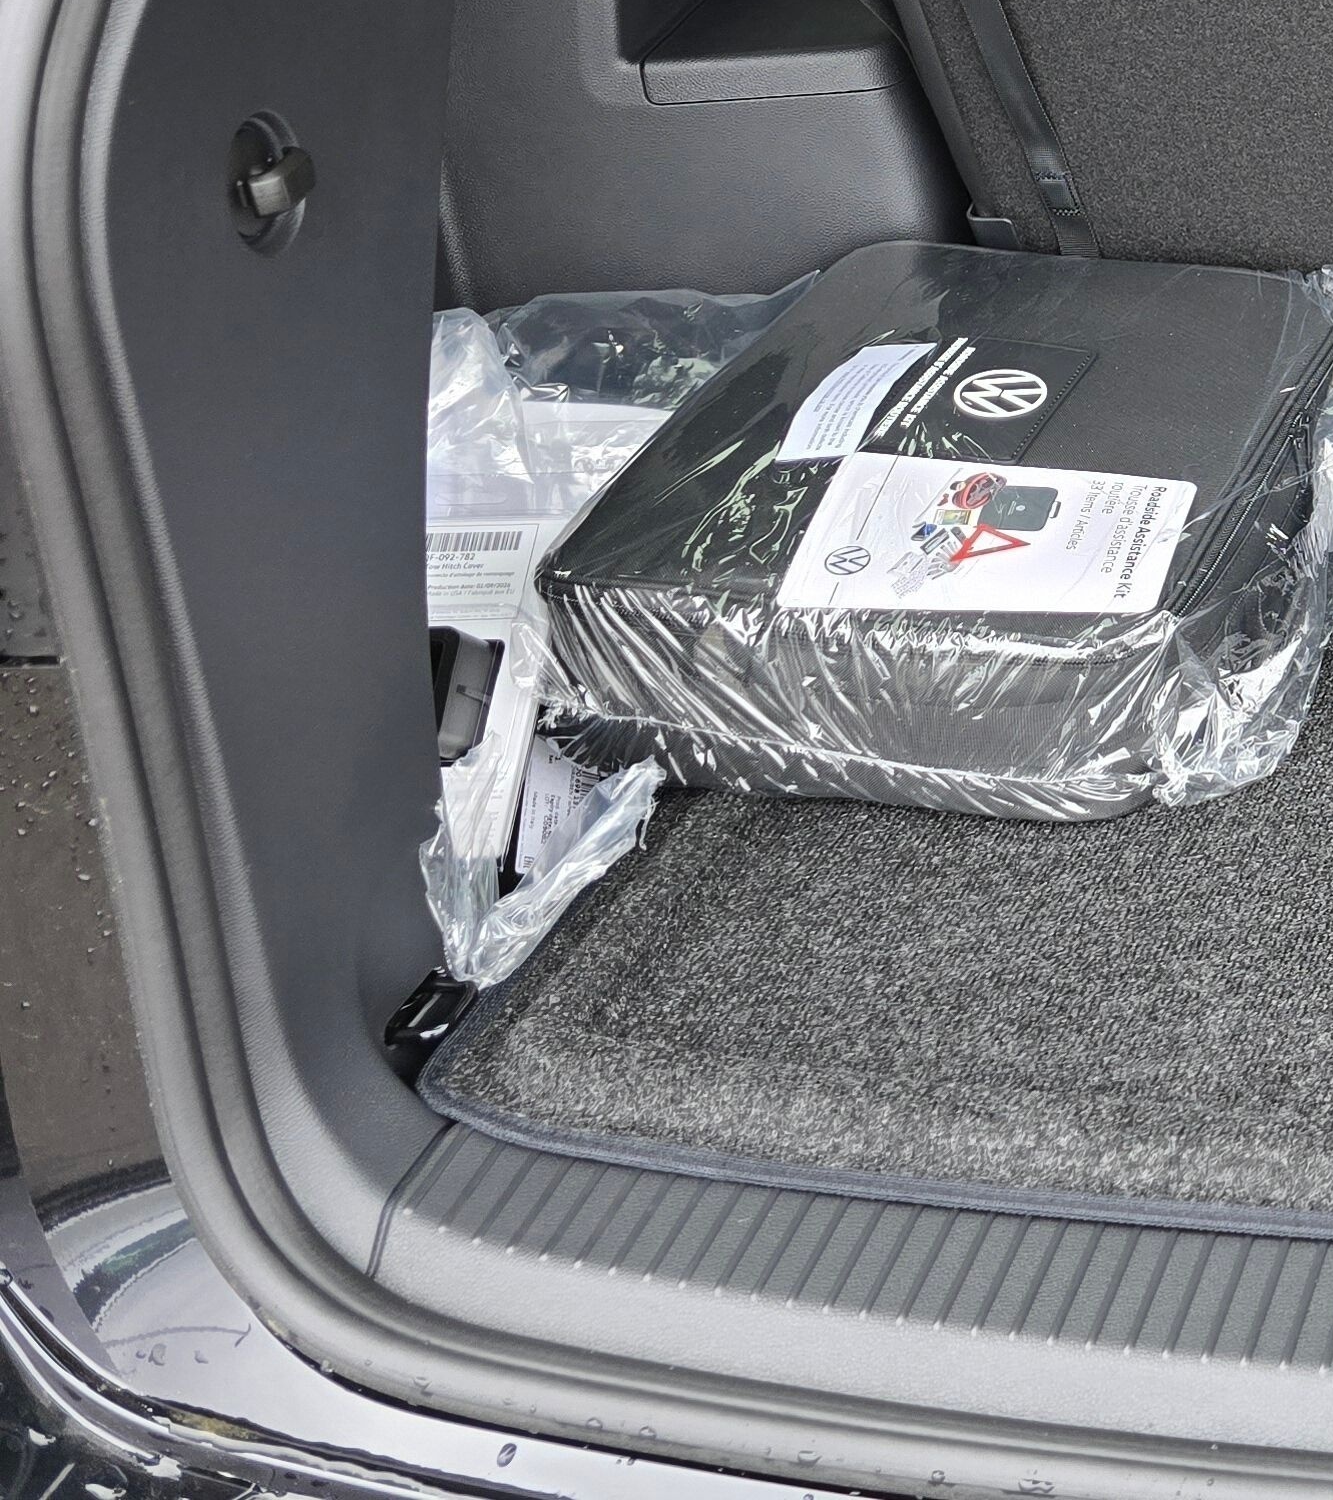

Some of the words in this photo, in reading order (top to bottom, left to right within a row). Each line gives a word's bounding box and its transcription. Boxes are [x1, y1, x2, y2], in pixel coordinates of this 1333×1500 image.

[1090, 480, 1105, 491] 33
[1123, 484, 1148, 515] Trousse
[1081, 491, 1101, 513] Items
[1140, 486, 1168, 525] Roadside
[1066, 519, 1089, 550] Articles
[1101, 516, 1134, 574] d'assistance
[441, 562, 462, 570] Hitch
[1120, 526, 1151, 580] Assistance
[1113, 582, 1133, 599] Kit
